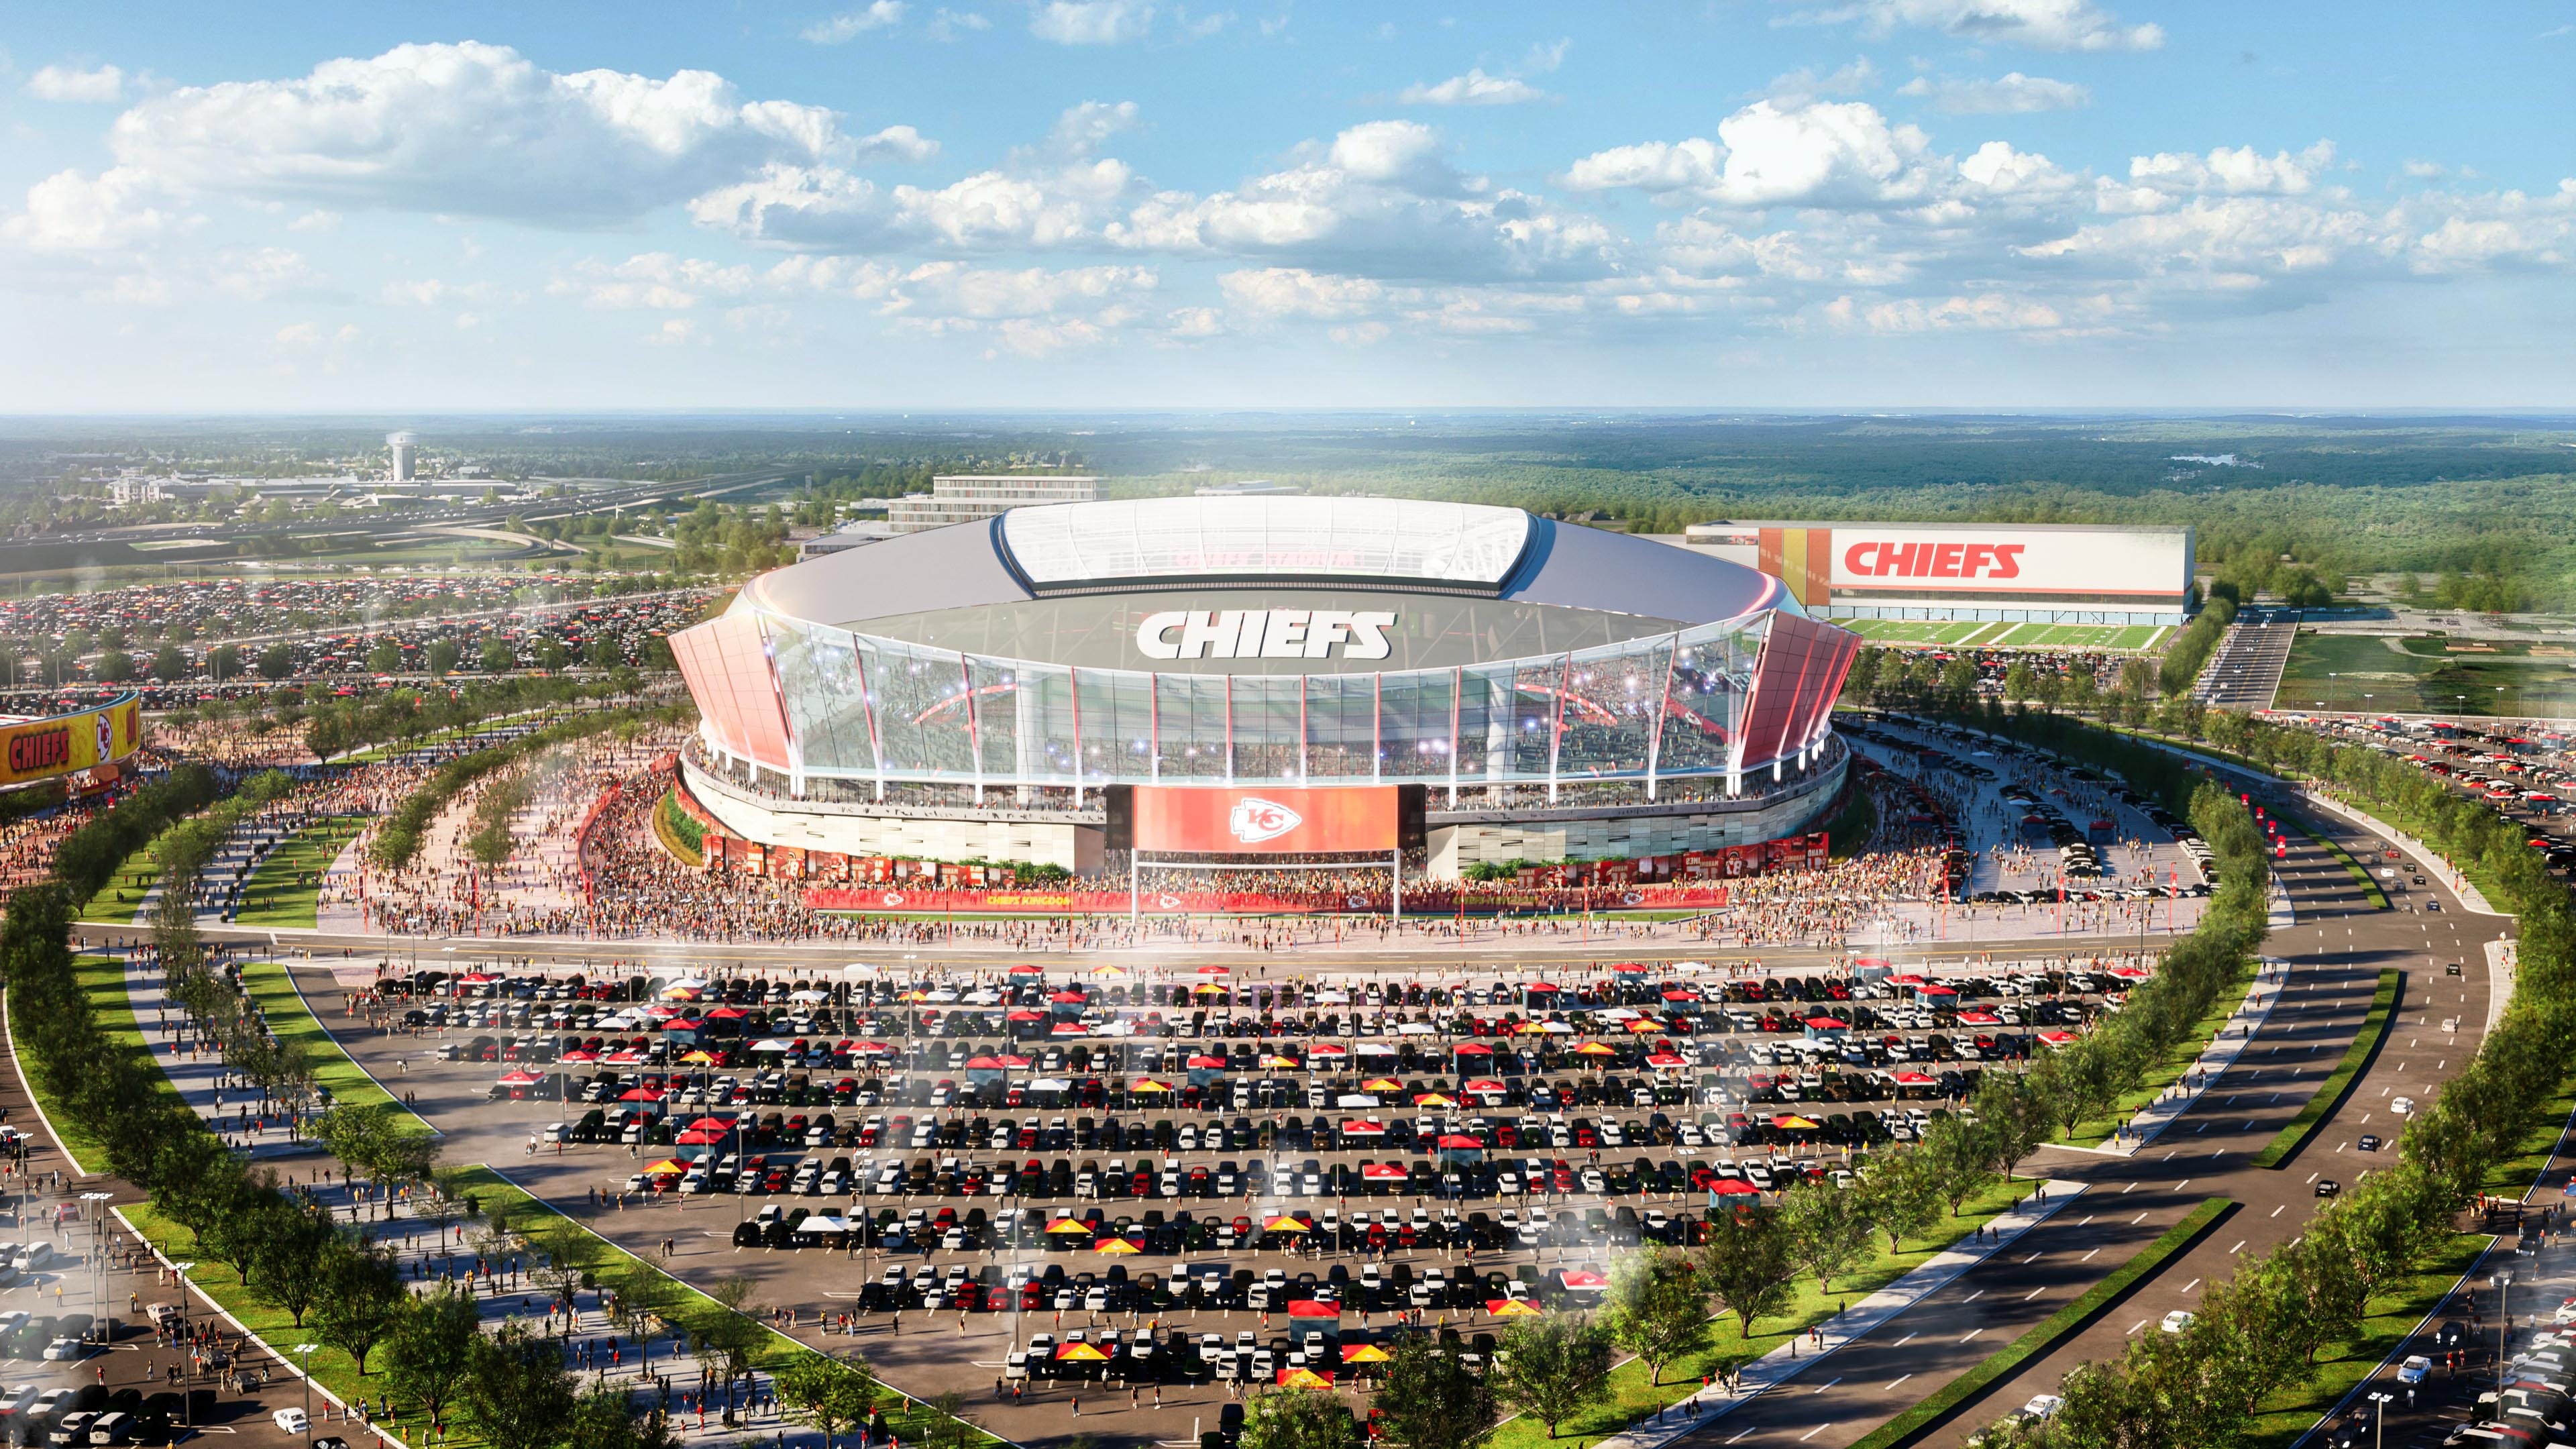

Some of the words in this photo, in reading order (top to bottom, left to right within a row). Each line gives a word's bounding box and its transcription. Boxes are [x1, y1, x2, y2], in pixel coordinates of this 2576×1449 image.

[1845, 542, 2025, 578] CHIEFS
[1136, 610, 1397, 659] CHIEFS
[10, 731, 69, 770] CHIEFS
[1248, 808, 1284, 831] KC
[987, 896, 1020, 904] CHIEFS
[1022, 896, 1073, 905] KINGDOM
